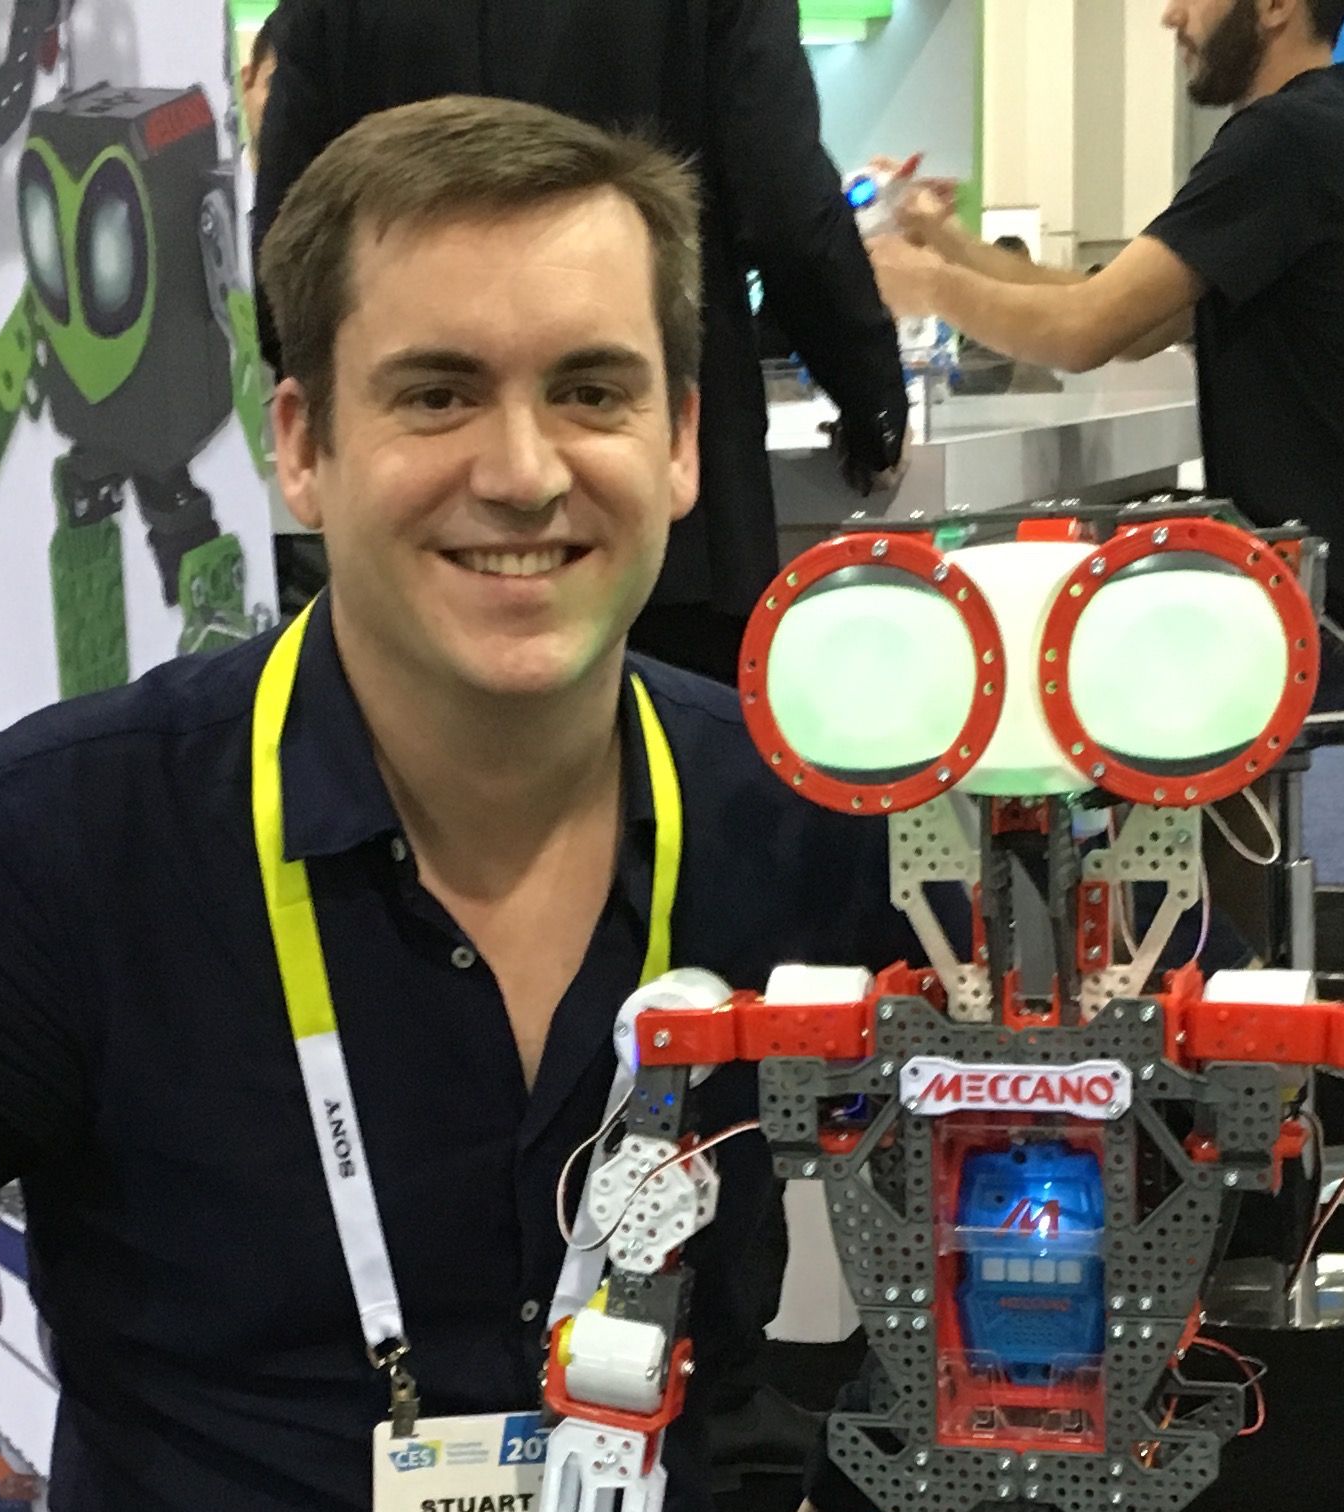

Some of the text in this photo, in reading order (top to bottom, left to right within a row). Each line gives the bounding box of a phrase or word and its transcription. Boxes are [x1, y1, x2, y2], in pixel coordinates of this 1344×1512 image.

[916, 1073, 1115, 1106] MECCANO
[323, 1099, 356, 1179] SONY
[394, 1449, 432, 1467] CES
